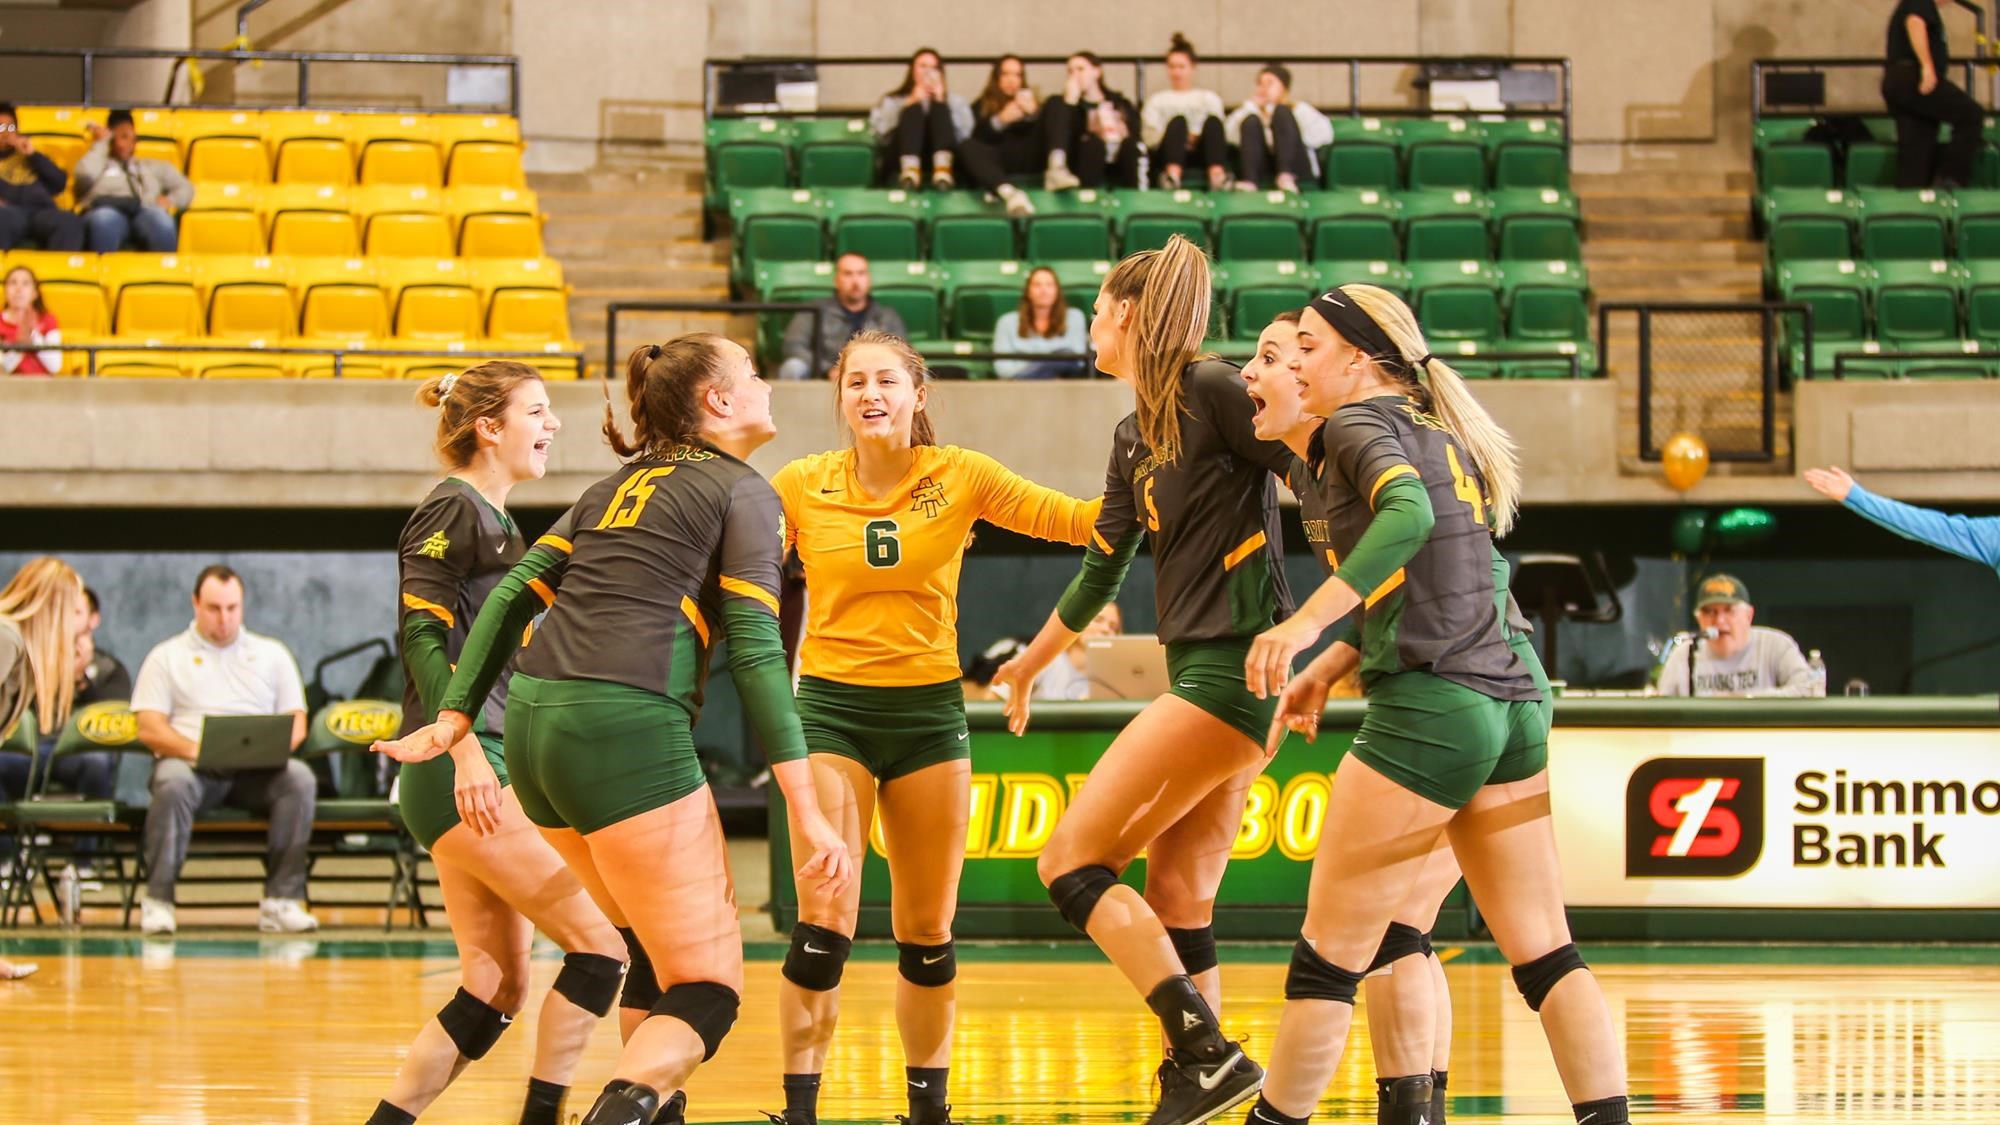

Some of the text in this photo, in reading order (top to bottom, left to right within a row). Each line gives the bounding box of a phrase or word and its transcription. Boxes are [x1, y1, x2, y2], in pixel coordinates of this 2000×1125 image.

[593, 465, 677, 530] 15
[864, 517, 902, 569] 6
[1793, 769, 2000, 816] Simmo
[1793, 822, 1946, 868] Bank
